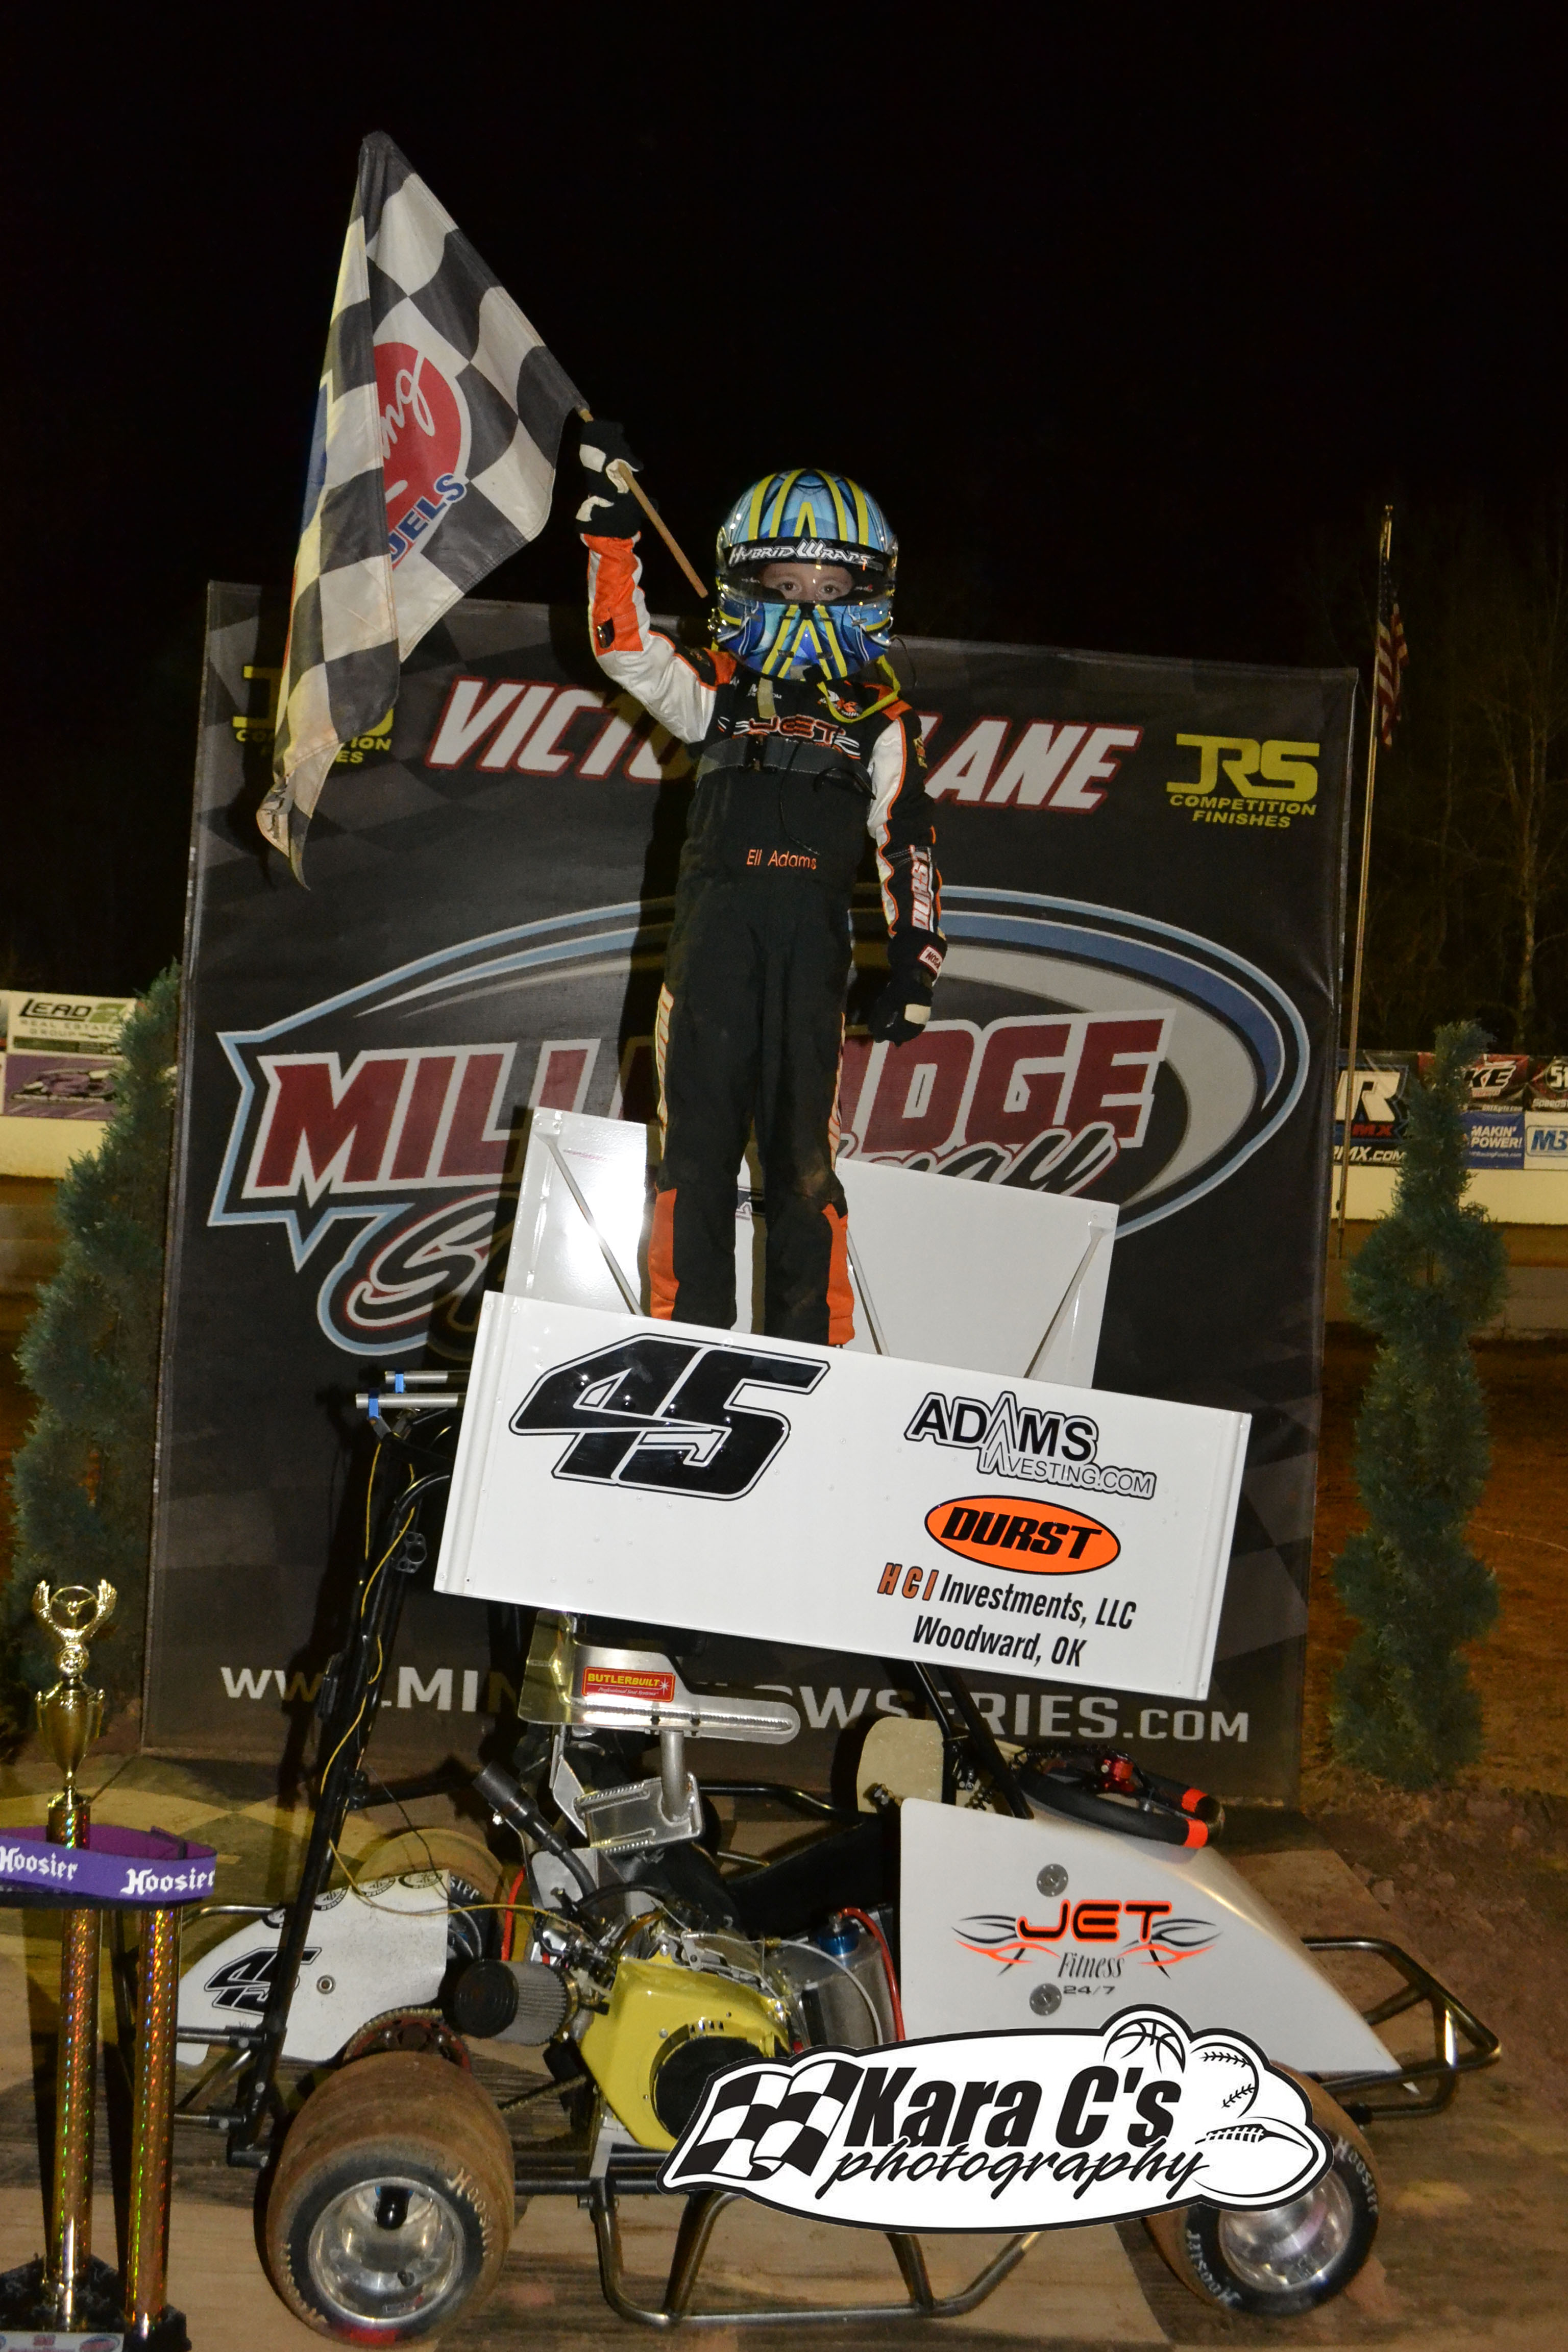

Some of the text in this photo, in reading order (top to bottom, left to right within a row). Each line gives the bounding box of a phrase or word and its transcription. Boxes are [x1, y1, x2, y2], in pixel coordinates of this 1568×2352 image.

[389, 473, 467, 564] UELS
[749, 714, 846, 745] JET
[1166, 733, 1320, 802] JRS
[1169, 794, 1316, 816] COMPETITION
[1193, 810, 1291, 828] FINISHES
[767, 850, 817, 870] Adams
[1471, 1125, 1517, 1137] MAKIN'
[1471, 1136, 1524, 1149] POWER!
[509, 1333, 831, 1501] 45
[903, 1390, 1099, 1466] ADAMS
[940, 1506, 1103, 1559] DURST
[939, 1573, 1087, 1628] Investments,
[1095, 1598, 1137, 1630] LLC
[912, 1615, 1088, 1667] Woodward, OK
[587, 1673, 660, 1687] BUTLERBUILT
[0, 1846, 78, 1881] Hoosier
[120, 1867, 216, 1896] Hoosier
[1015, 1898, 1172, 1943] JET
[1058, 1951, 1125, 1979] Fitness
[1063, 1984, 1116, 1996] 24/7
